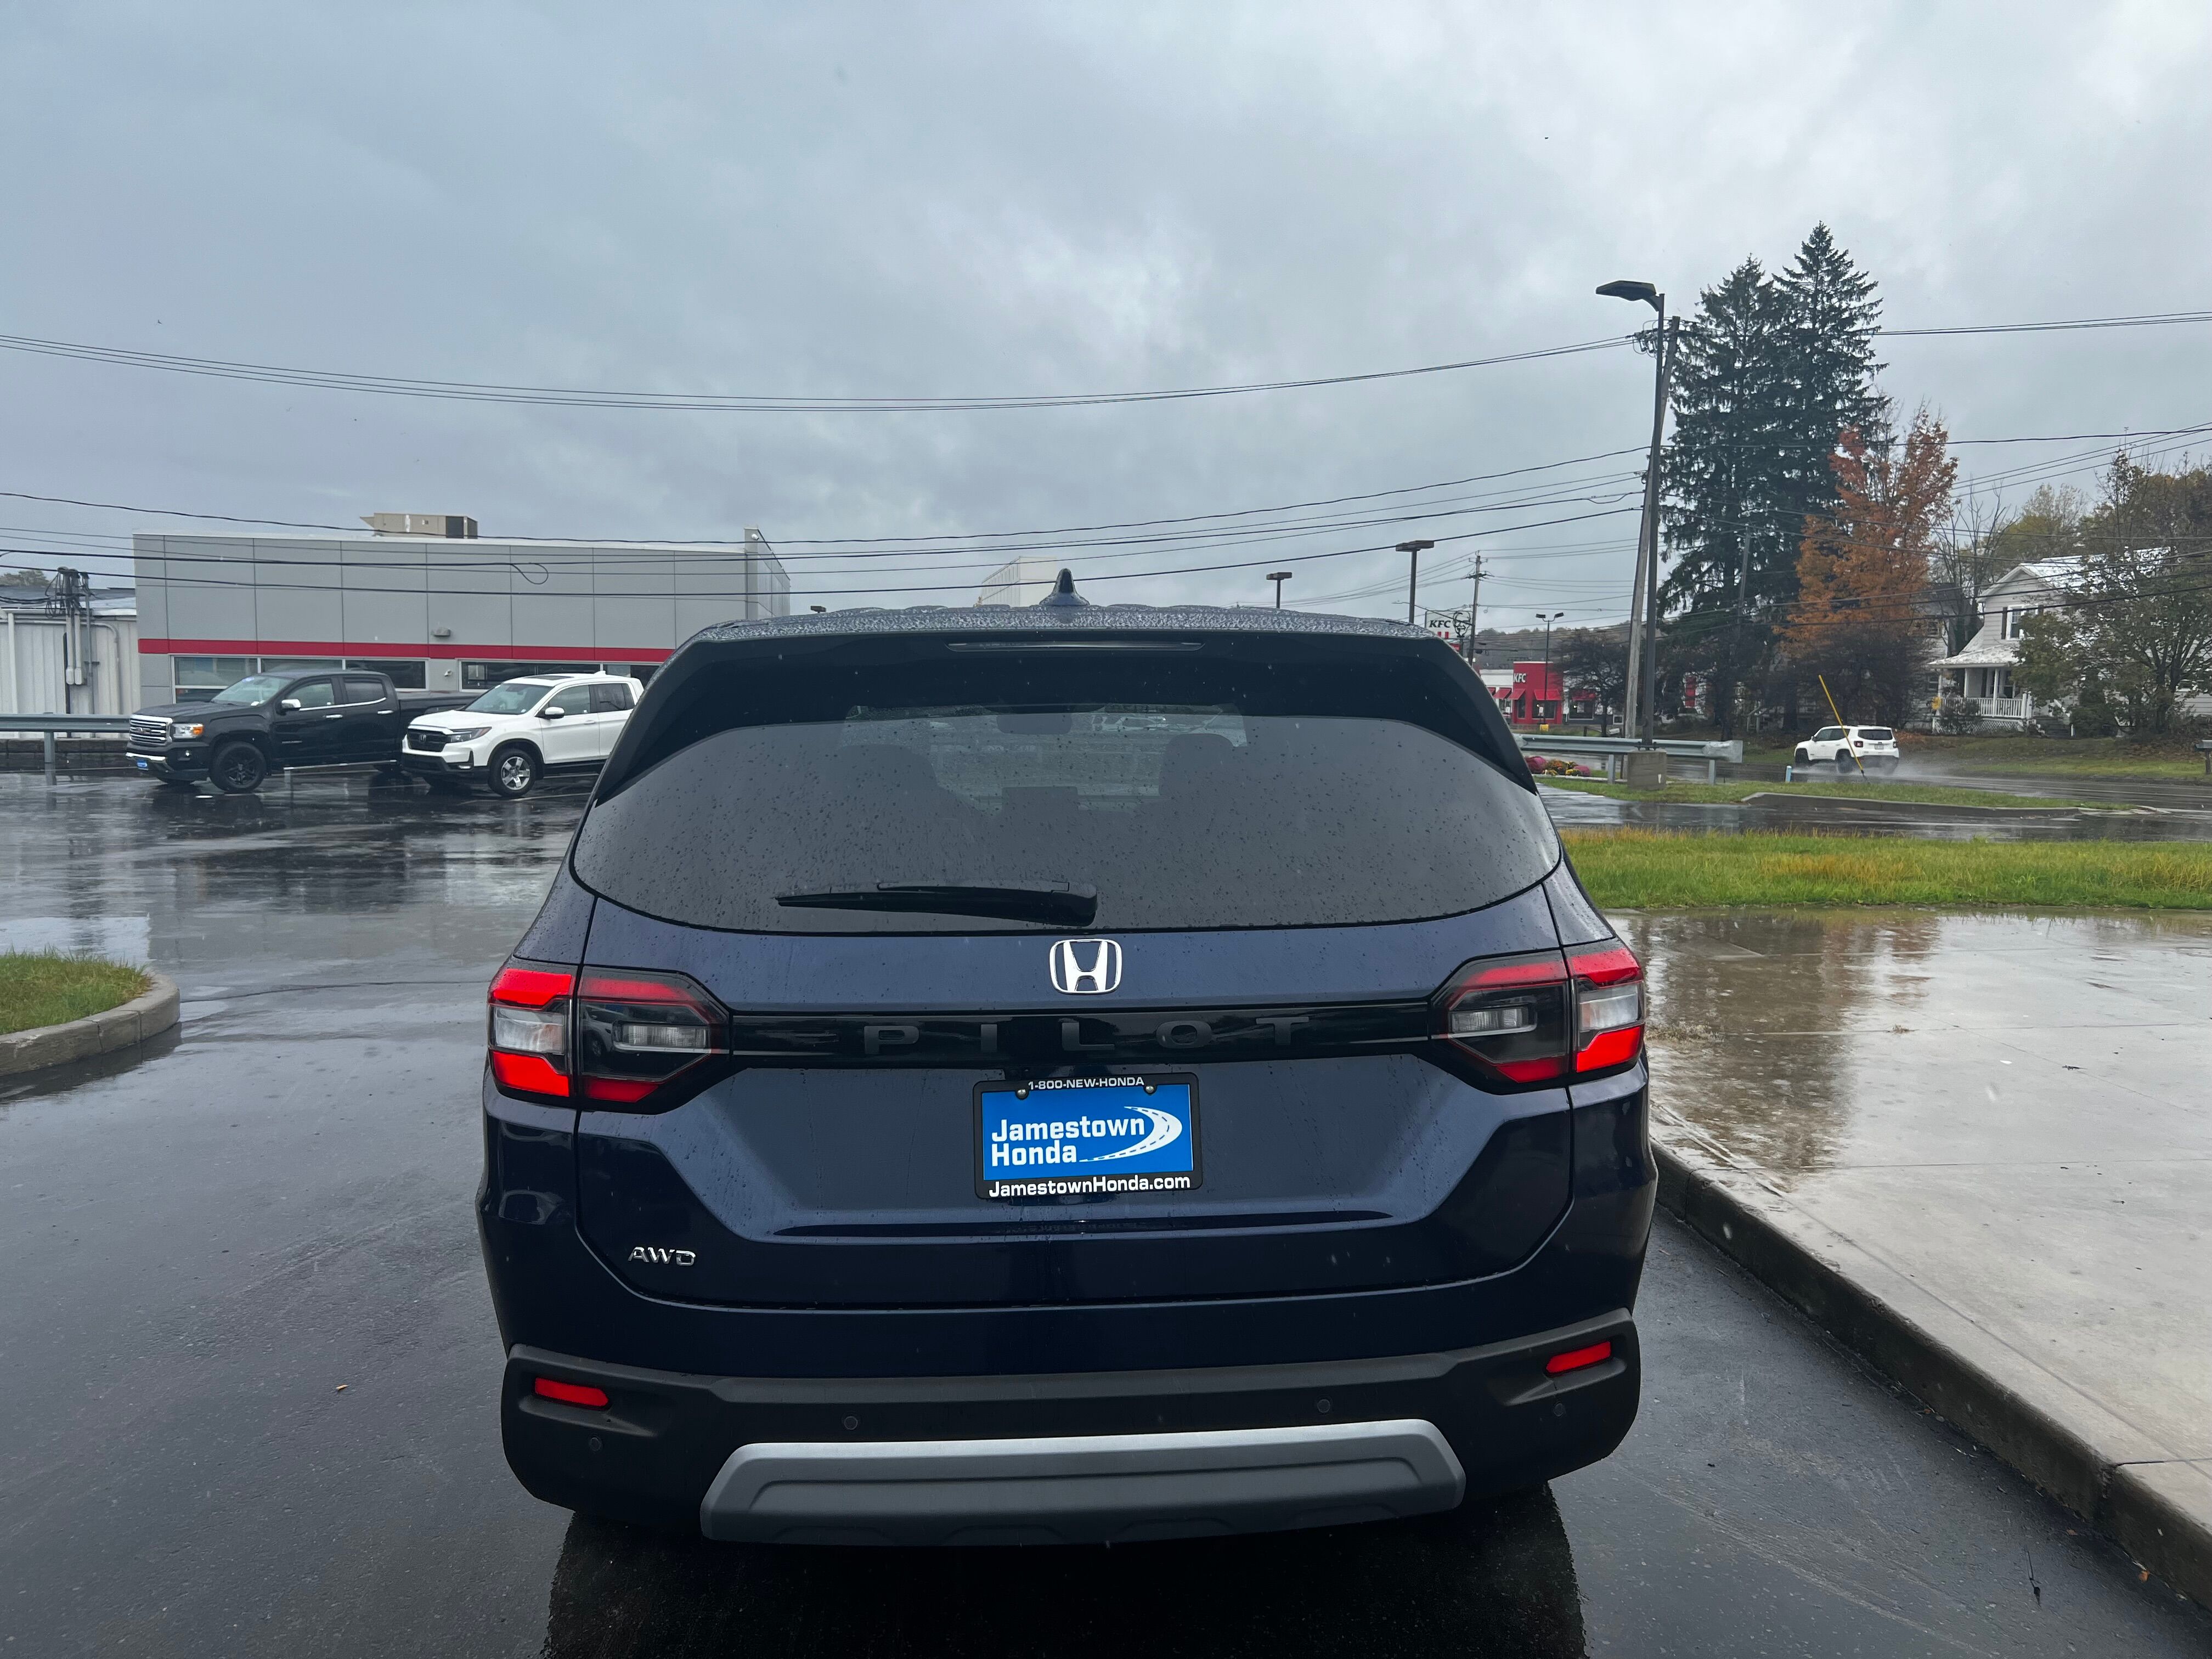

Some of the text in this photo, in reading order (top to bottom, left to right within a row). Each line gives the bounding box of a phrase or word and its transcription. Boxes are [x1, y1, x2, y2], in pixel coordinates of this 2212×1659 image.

[1429, 620, 1451, 628] KFC
[1513, 673, 1526, 683] KFC
[864, 1017, 1310, 1054] PILOT
[1028, 1076, 1145, 1090] 1-800-NEW-HONDA
[991, 1116, 1144, 1141] Jamestown
[991, 1139, 1077, 1167] Honda
[989, 1175, 1190, 1197] JamestownHonda.com
[628, 1246, 696, 1266] AWD
